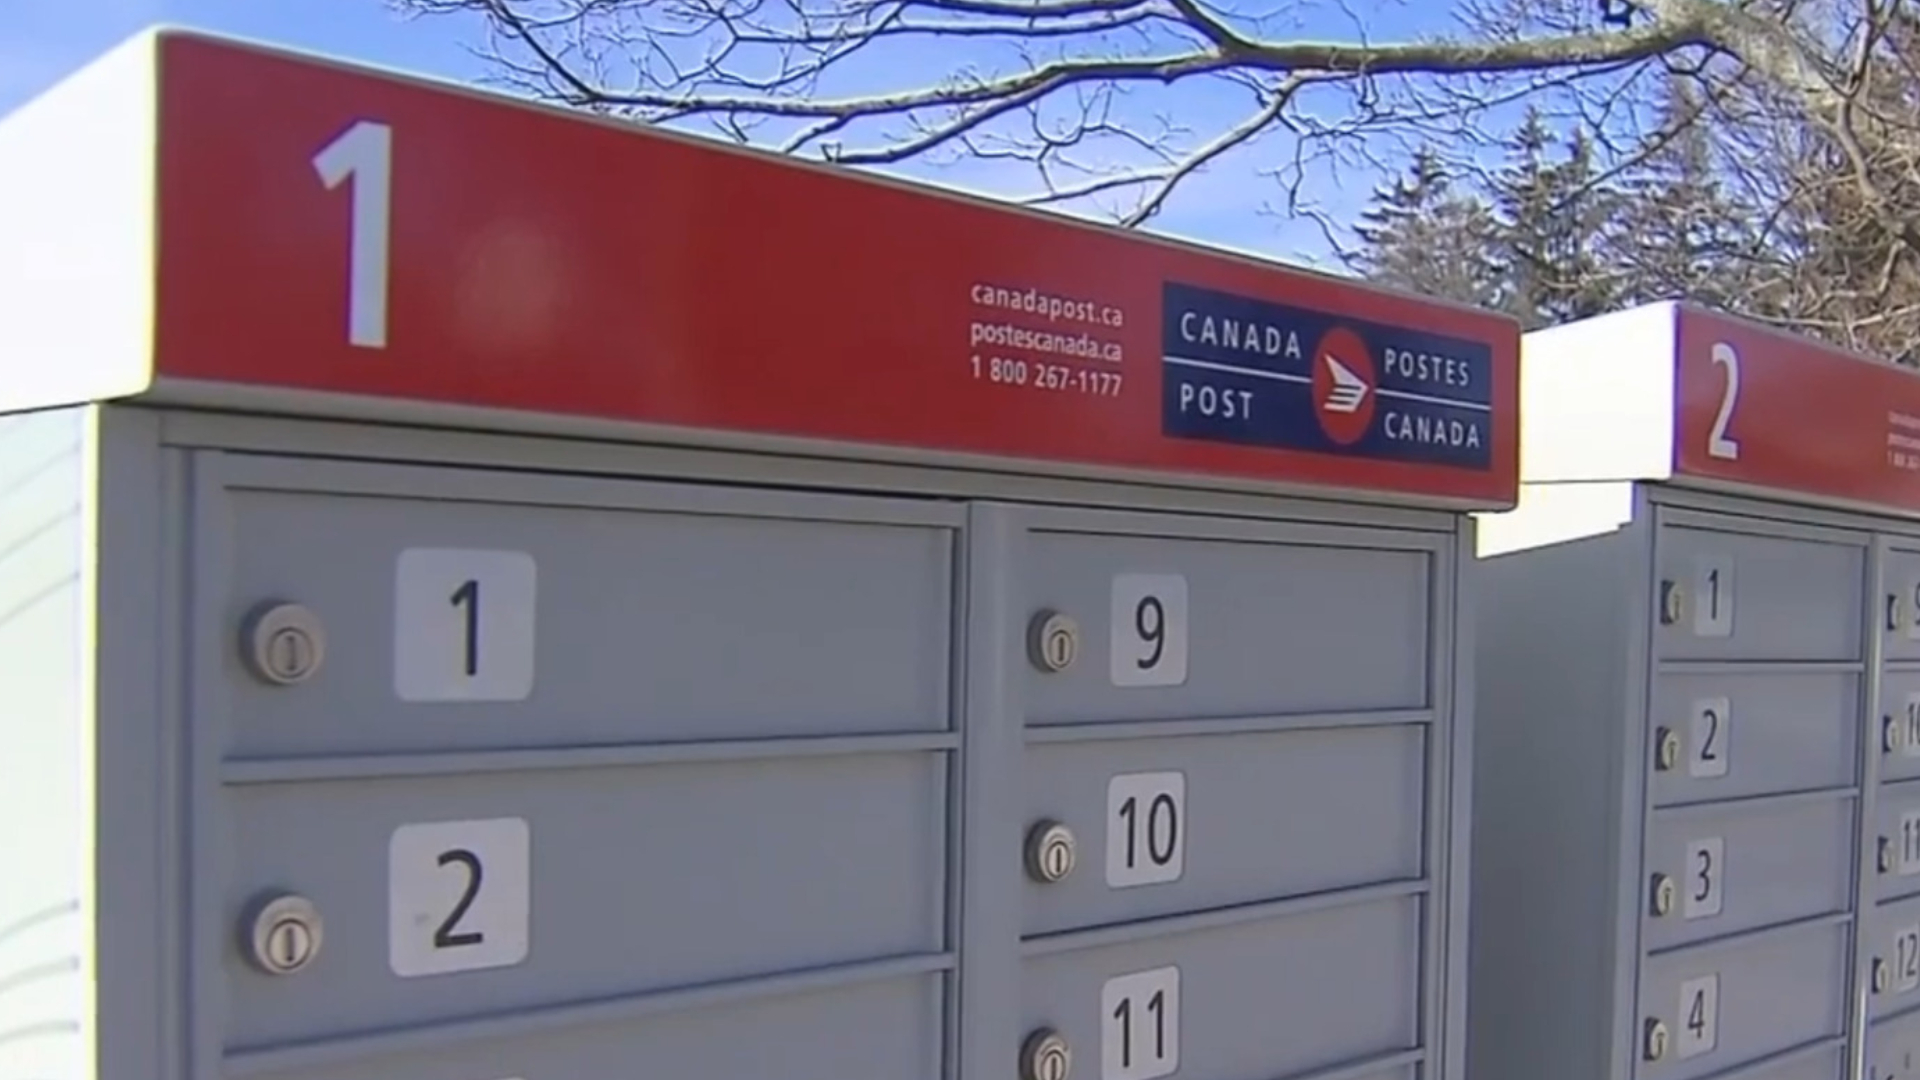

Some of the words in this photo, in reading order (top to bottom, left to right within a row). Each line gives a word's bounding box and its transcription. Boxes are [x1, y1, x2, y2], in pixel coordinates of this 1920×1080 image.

[311, 120, 391, 347] 1
[971, 284, 1123, 327] canadapost.ca
[971, 323, 1122, 361] postescanada.ca
[1181, 312, 1301, 359] CANADA
[971, 355, 980, 378] 1
[990, 357, 1026, 384] 800
[1034, 363, 1122, 397] 267-1177
[1385, 349, 1469, 386] POSTES
[1181, 384, 1253, 418] POST
[1709, 342, 1739, 459] 2
[1384, 412, 1480, 448] CANADA
[1708, 568, 1718, 620] 1
[450, 580, 478, 676] 1
[1136, 596, 1164, 669] 9
[1701, 708, 1717, 761] 2
[1119, 794, 1176, 868] 10
[434, 849, 483, 948] 2
[1695, 850, 1711, 902] 3
[1897, 933, 1917, 980] 12
[1114, 990, 1163, 1068] 11
[1688, 989, 1705, 1039] 4
